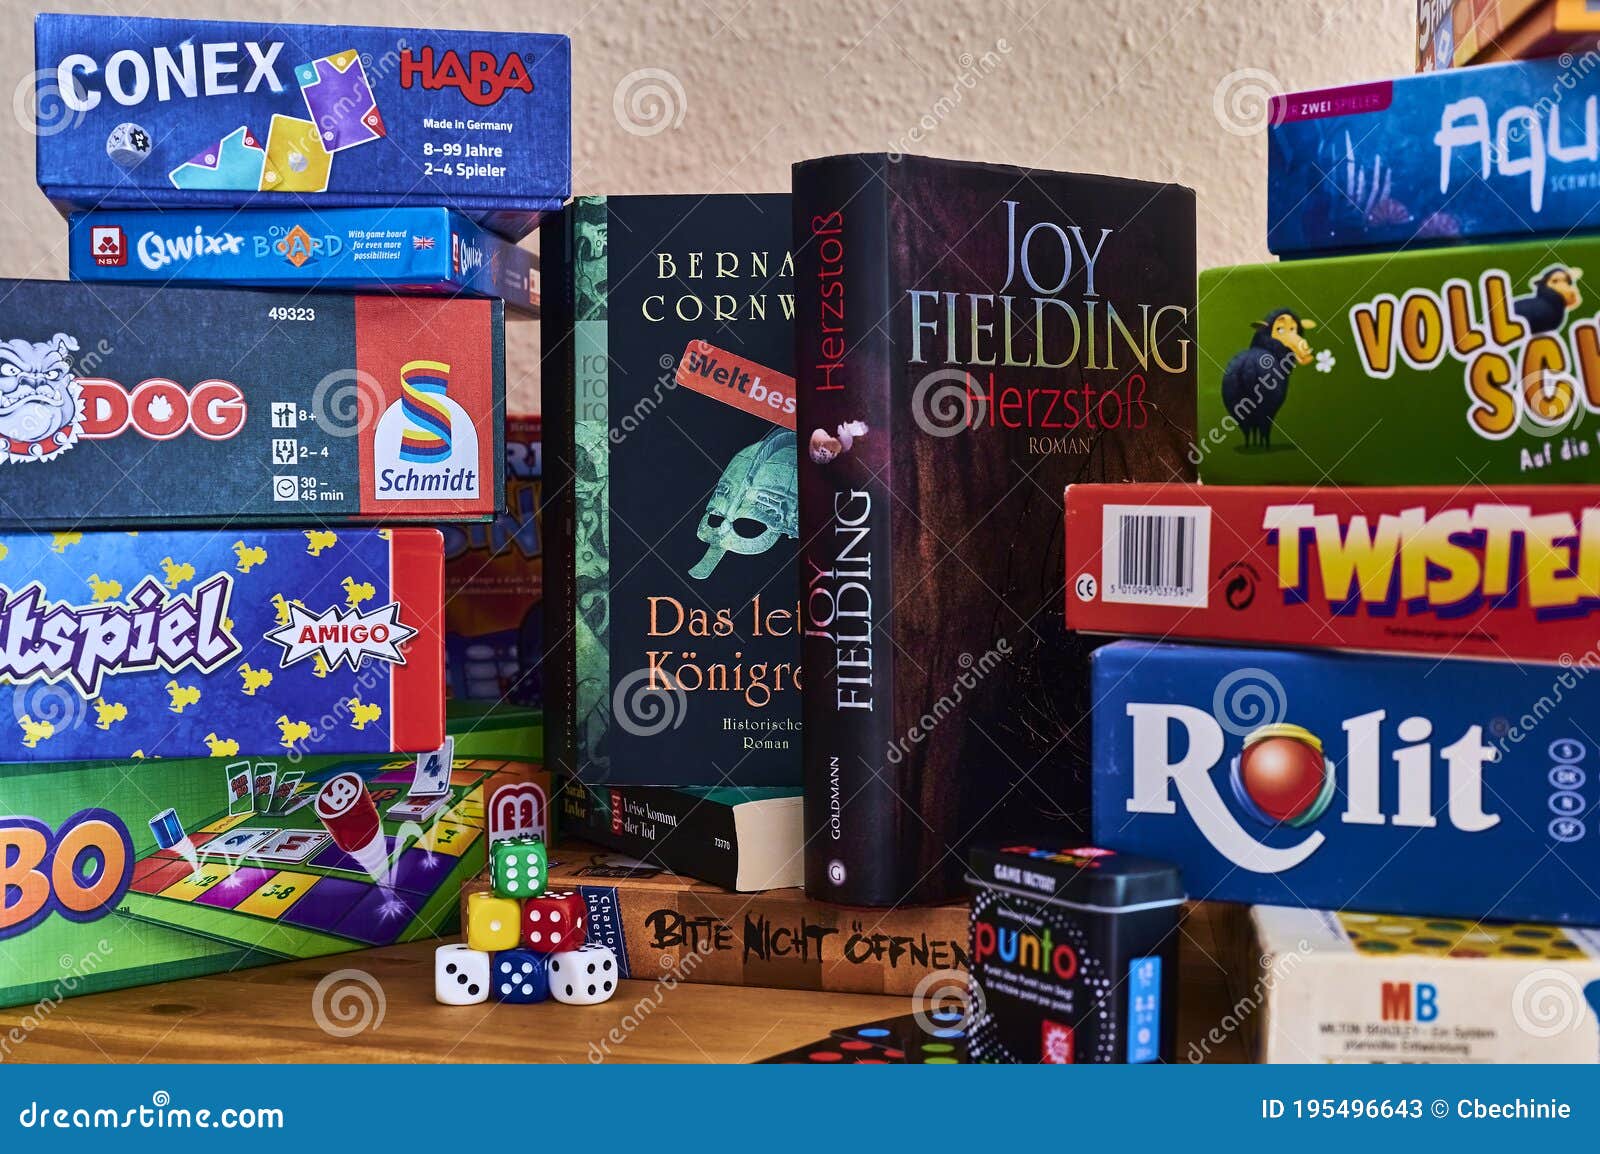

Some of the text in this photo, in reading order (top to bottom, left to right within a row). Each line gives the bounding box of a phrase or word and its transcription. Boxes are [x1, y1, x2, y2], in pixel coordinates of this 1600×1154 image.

[57, 41, 285, 112] CONEX
[400, 46, 535, 107] HABA
[423, 118, 447, 129] Made
[467, 119, 513, 133] Germany
[1301, 101, 1331, 115] ZWEI
[465, 143, 503, 158] Jahre
[456, 163, 506, 179] Spieler
[137, 225, 245, 270] Qwixx
[253, 234, 343, 258] BOARD
[268, 225, 291, 237] ON
[348, 229, 407, 240] With game board
[353, 241, 402, 250] for even more
[1000, 200, 1114, 297] JOY
[354, 251, 401, 261] possibilities!
[657, 251, 794, 280] BERNA
[268, 307, 316, 321] 49323
[811, 211, 845, 391] Herzstoß
[906, 289, 1191, 374] FIELDING
[1352, 272, 1526, 375] VOLL
[75, 378, 248, 441] DOG
[299, 410, 317, 421] 8+
[966, 372, 1148, 430] Herzstoß
[1029, 436, 1091, 454] ROMAN
[300, 489, 344, 501] 45 min
[379, 467, 476, 492] Schmidt
[646, 596, 735, 637] Das
[804, 557, 838, 644] JOY
[834, 488, 874, 712] FIELDING
[0, 575, 238, 696] tspiel
[298, 623, 390, 644] AMIGO
[743, 736, 790, 749] Roman
[830, 756, 841, 840] GOLDMANN
[1126, 702, 1501, 874] Rolit
[623, 797, 678, 828] Leise kommt
[624, 817, 656, 840] der Tod
[601, 896, 617, 957] Charlot
[645, 909, 734, 953] BITTE
[744, 911, 839, 964] NICHT
[975, 921, 1077, 979] punto
[1381, 982, 1439, 1022] MB
